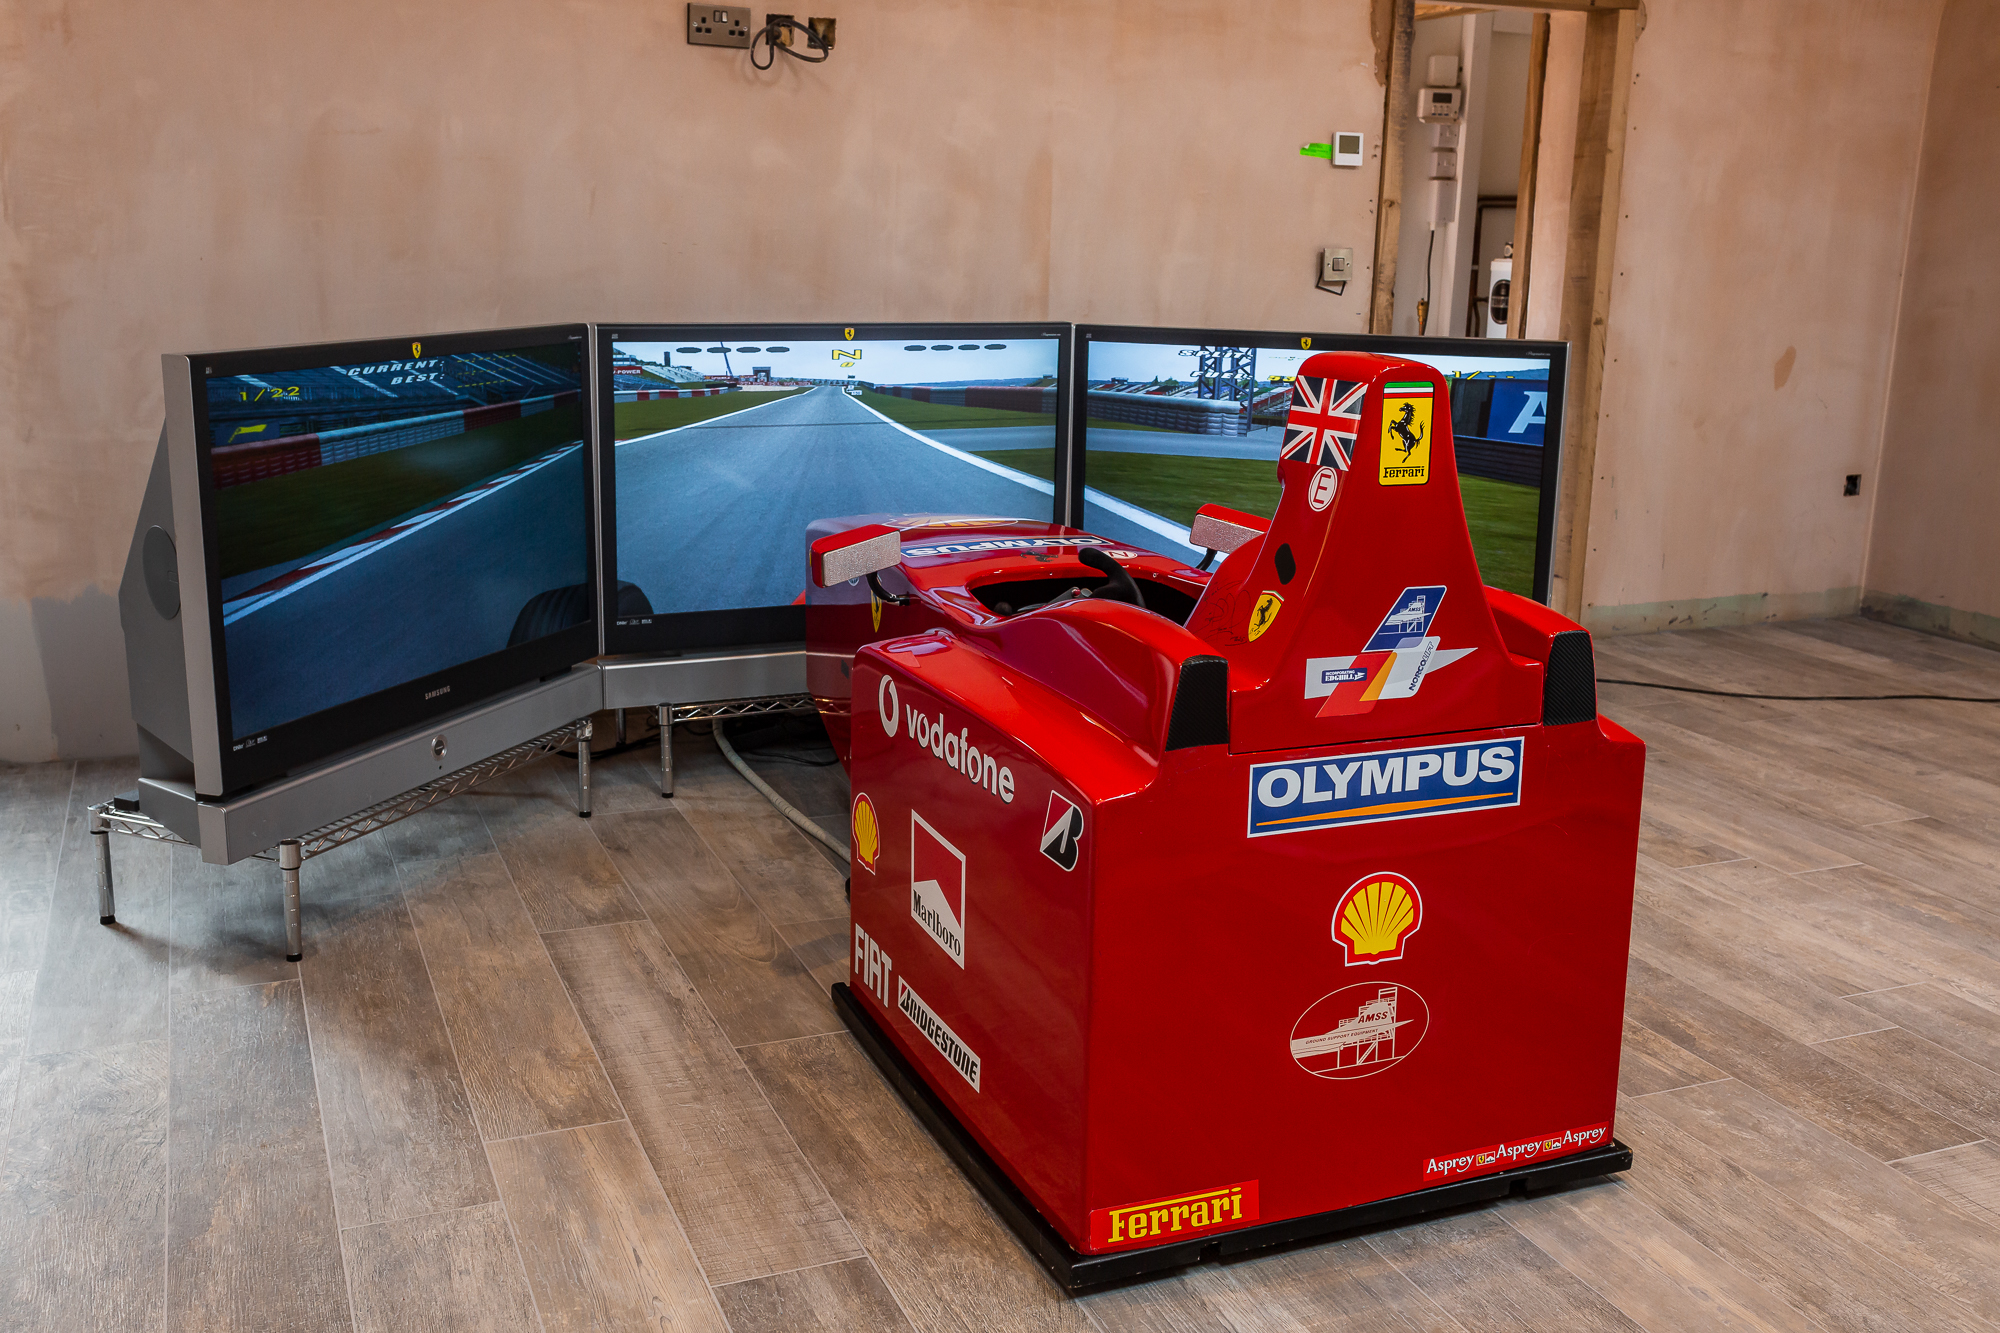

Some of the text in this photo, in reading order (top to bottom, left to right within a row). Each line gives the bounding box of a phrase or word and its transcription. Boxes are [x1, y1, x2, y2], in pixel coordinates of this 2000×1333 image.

[831, 349, 862, 361] N
[390, 373, 445, 386] BEST:
[1312, 472, 1332, 504] E
[1383, 465, 1425, 478] Ferrari
[905, 537, 1103, 556] OLYMPUS
[424, 685, 451, 701] SAMSUNG
[905, 703, 1015, 804] vodafone
[1257, 746, 1515, 808] OLYMPUS
[912, 889, 962, 957] Marlboro
[854, 923, 893, 1009] FIAT
[900, 986, 979, 1084] BRIDGESTONE
[1357, 1011, 1389, 1024] AMSS
[1426, 1154, 1475, 1176] Asprey
[1496, 1140, 1542, 1160] Asprey
[1562, 1126, 1607, 1146] Asprey
[1107, 1186, 1243, 1243] Ferrari
